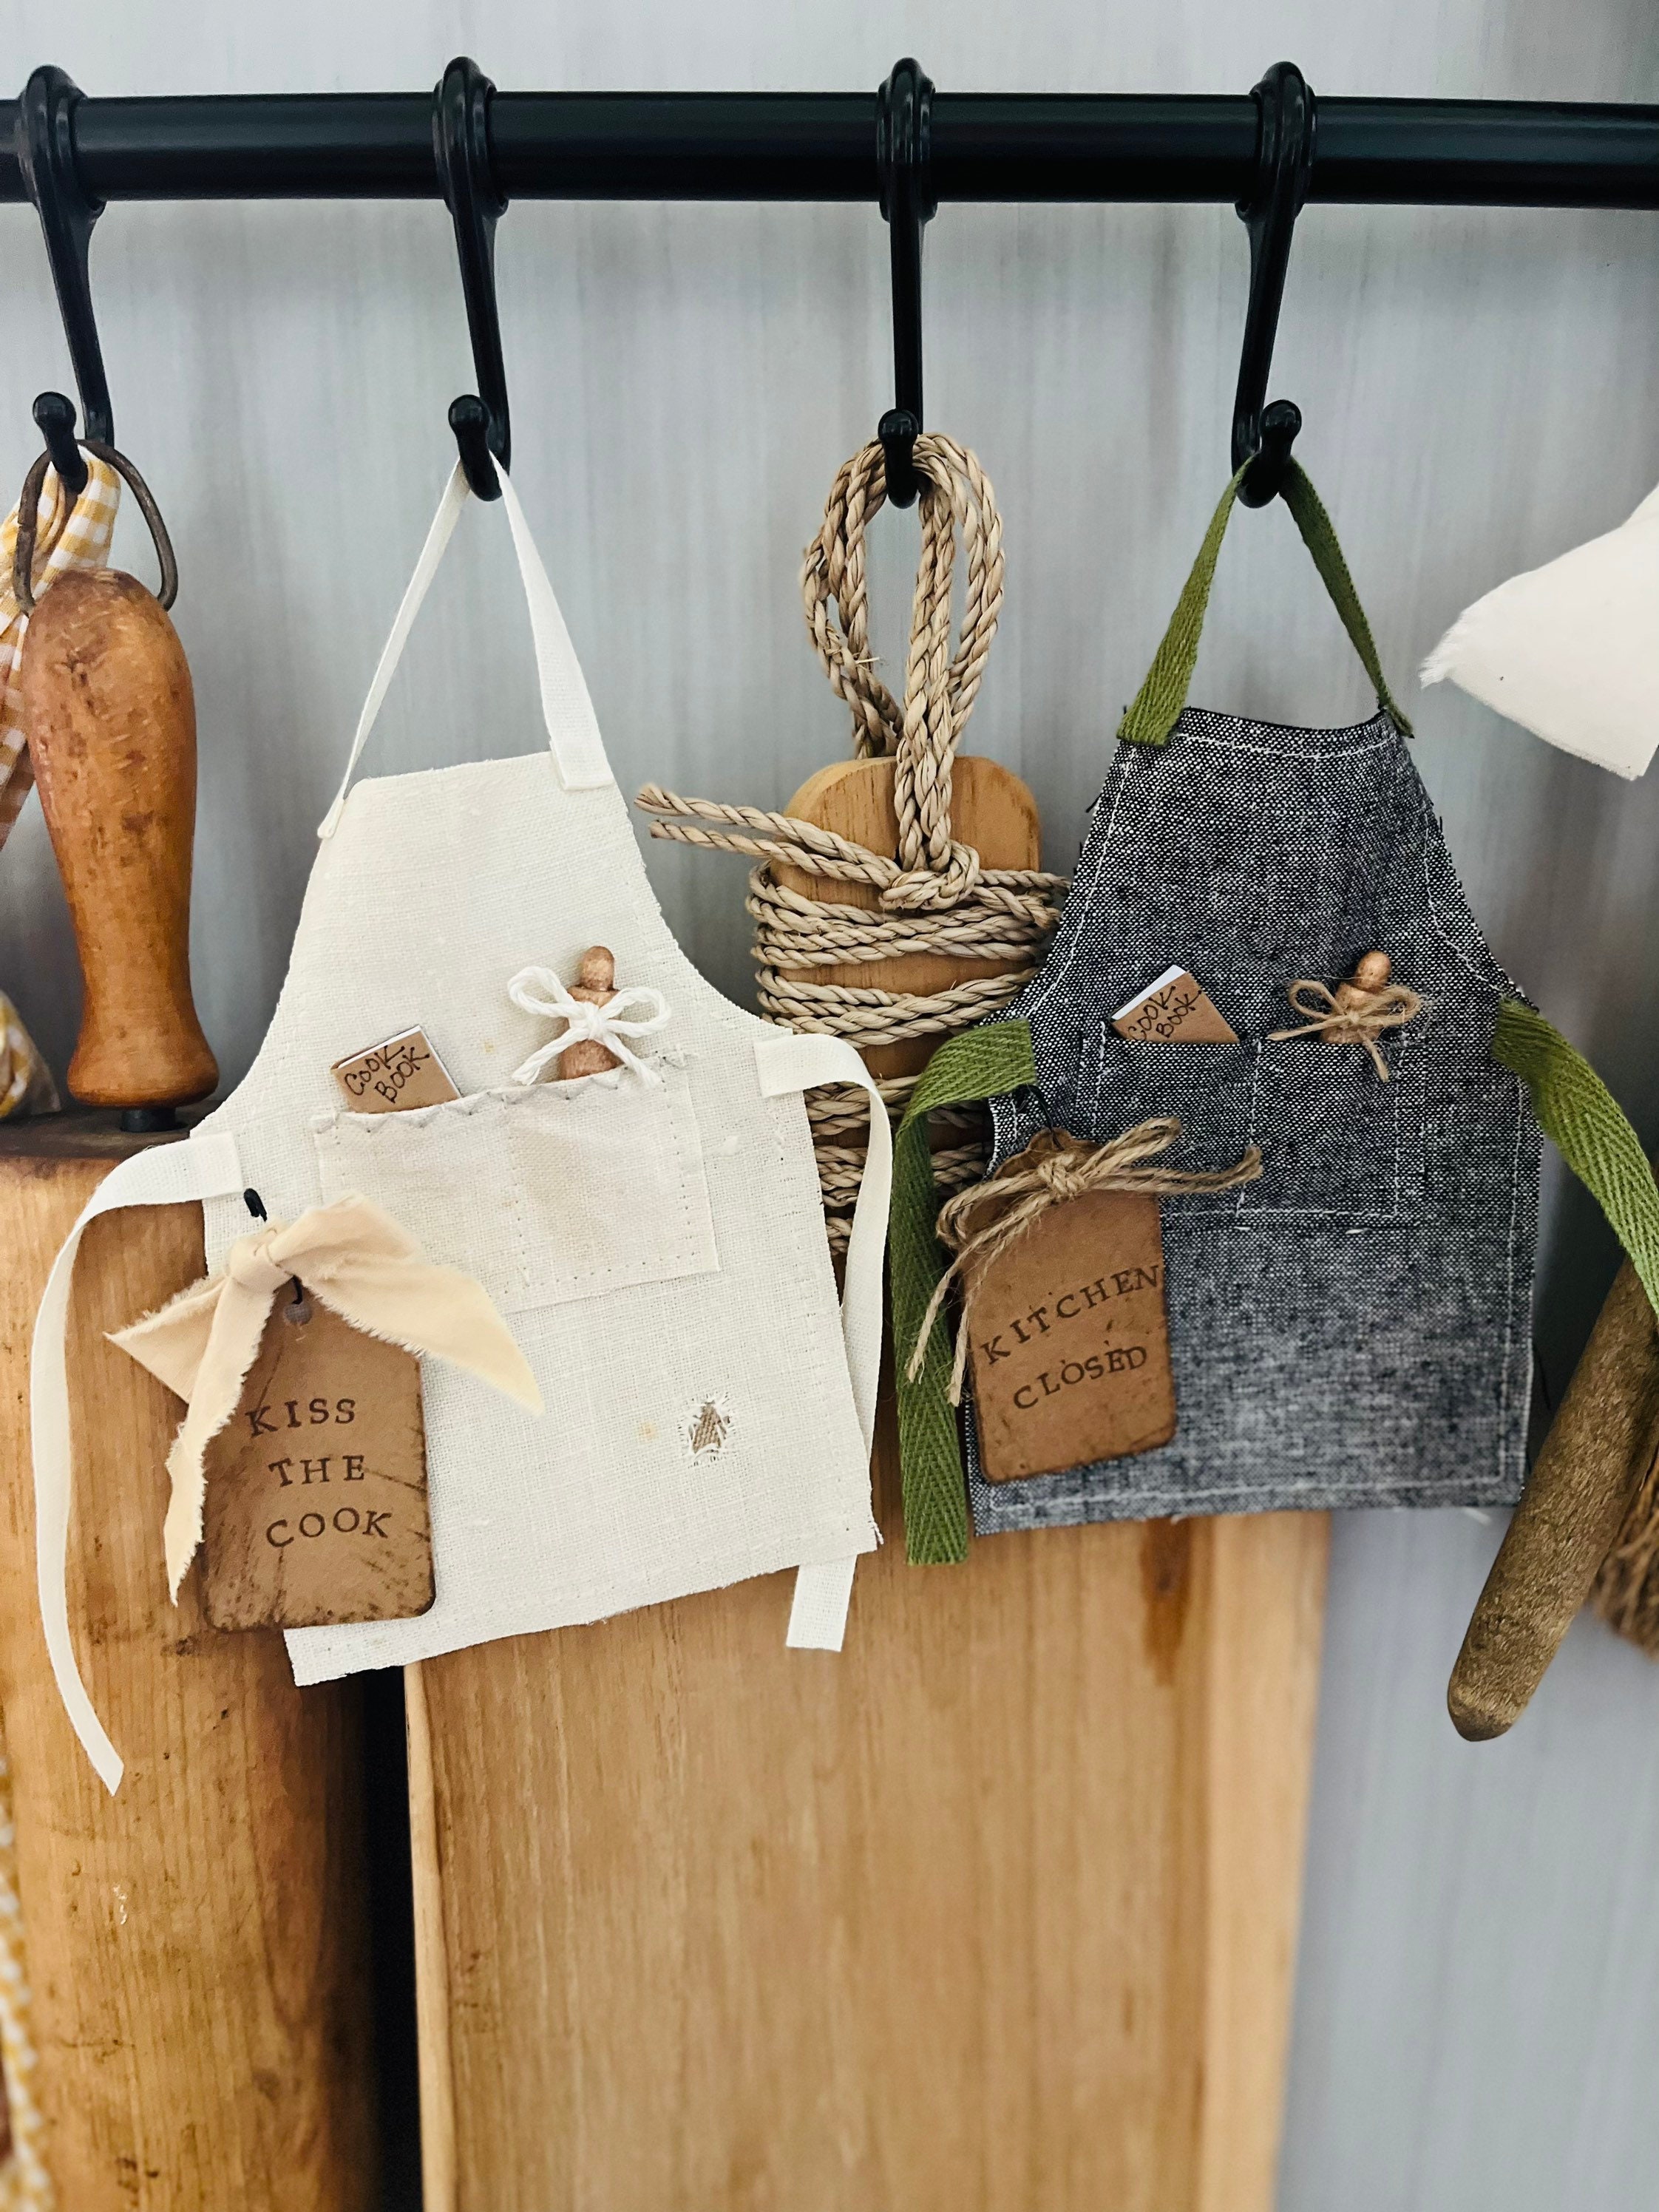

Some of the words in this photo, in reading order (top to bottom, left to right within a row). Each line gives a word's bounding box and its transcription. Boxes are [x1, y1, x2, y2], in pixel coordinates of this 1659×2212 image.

[1127, 985, 1176, 1042] COOK
[1156, 990, 1202, 1038] BOOK
[345, 1045, 405, 1096] COOK
[374, 1047, 430, 1104] BOOK
[980, 1265, 1159, 1365] KITCHEN
[1013, 1346, 1147, 1410] CLOSED
[244, 1398, 356, 1438] KISS
[268, 1454, 365, 1487] THE
[265, 1507, 393, 1548] COOK
